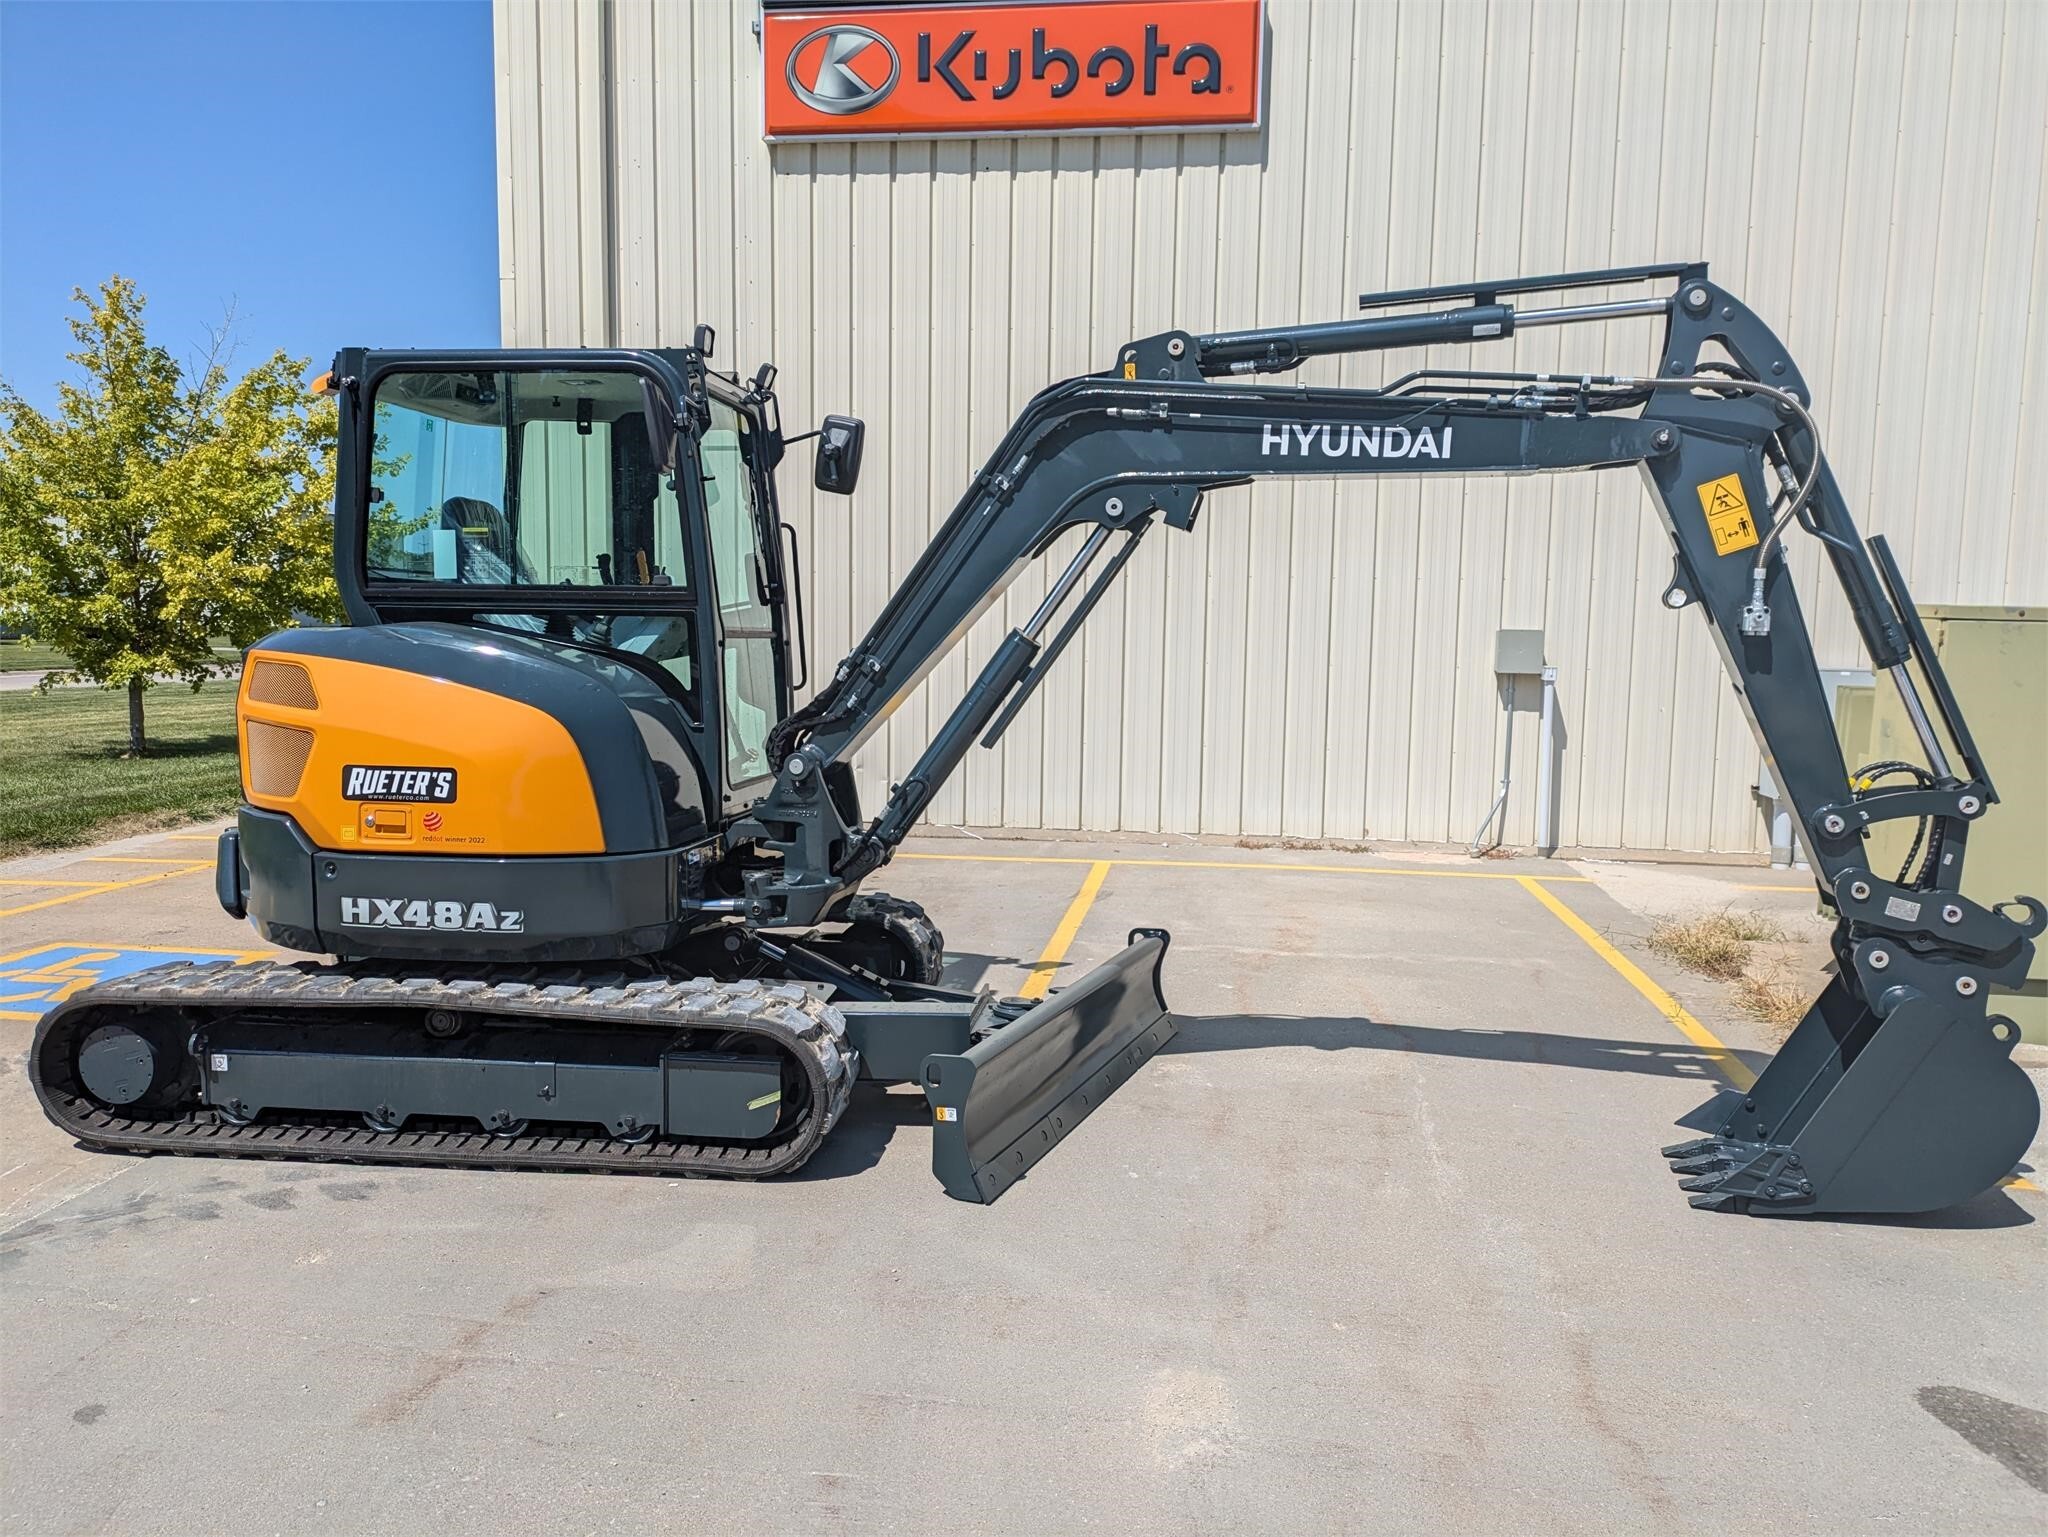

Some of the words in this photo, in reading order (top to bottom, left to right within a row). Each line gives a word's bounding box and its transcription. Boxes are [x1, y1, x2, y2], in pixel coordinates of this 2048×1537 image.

[918, 24, 1221, 101] Kubota
[1261, 423, 1453, 459] HYUNDAI
[346, 767, 453, 798] RUETER'S
[367, 793, 430, 801] www.rueterco.com
[468, 836, 486, 844] 2022
